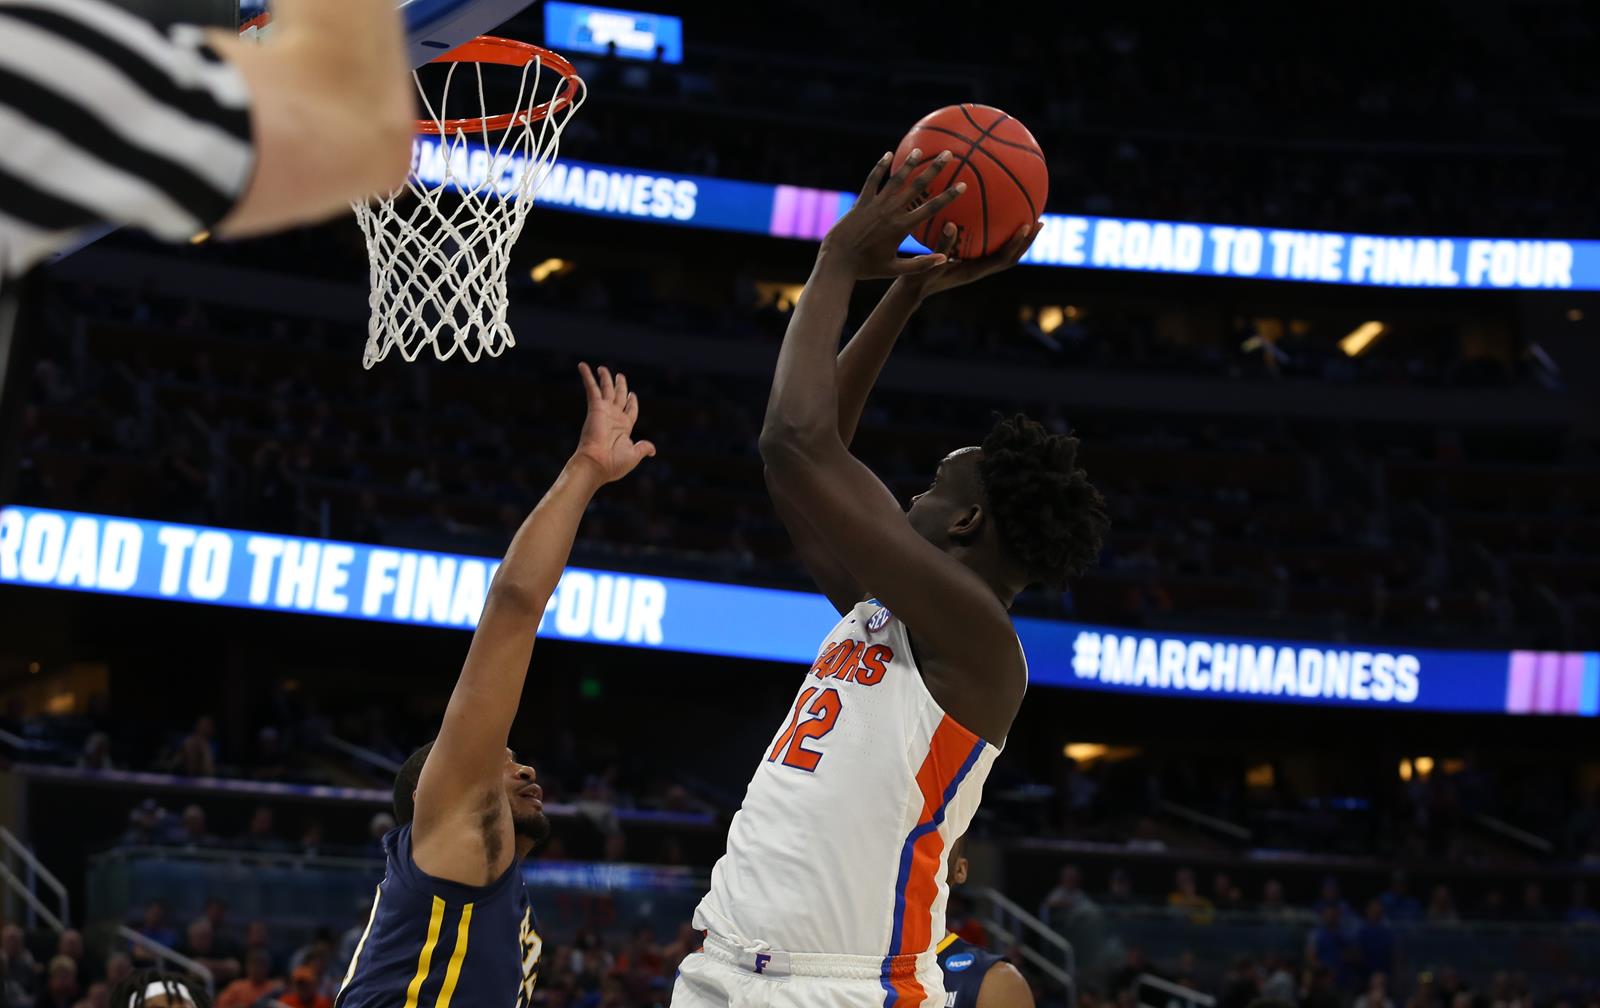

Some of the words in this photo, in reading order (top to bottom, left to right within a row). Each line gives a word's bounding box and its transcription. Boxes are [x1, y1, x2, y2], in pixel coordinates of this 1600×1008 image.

[1019, 214, 1089, 266] HE
[1091, 218, 1203, 273] ROAD
[1210, 226, 1263, 276] TO
[1268, 230, 1345, 282] THE
[1348, 235, 1460, 287] FINAL
[1465, 239, 1573, 288] FOUR
[0, 508, 143, 591] ROAD
[157, 526, 233, 601] TO
[246, 535, 355, 613] THE
[538, 569, 667, 645] OUR
[1071, 631, 1421, 703] #MARCHMADNESS
[767, 686, 843, 773] 12
